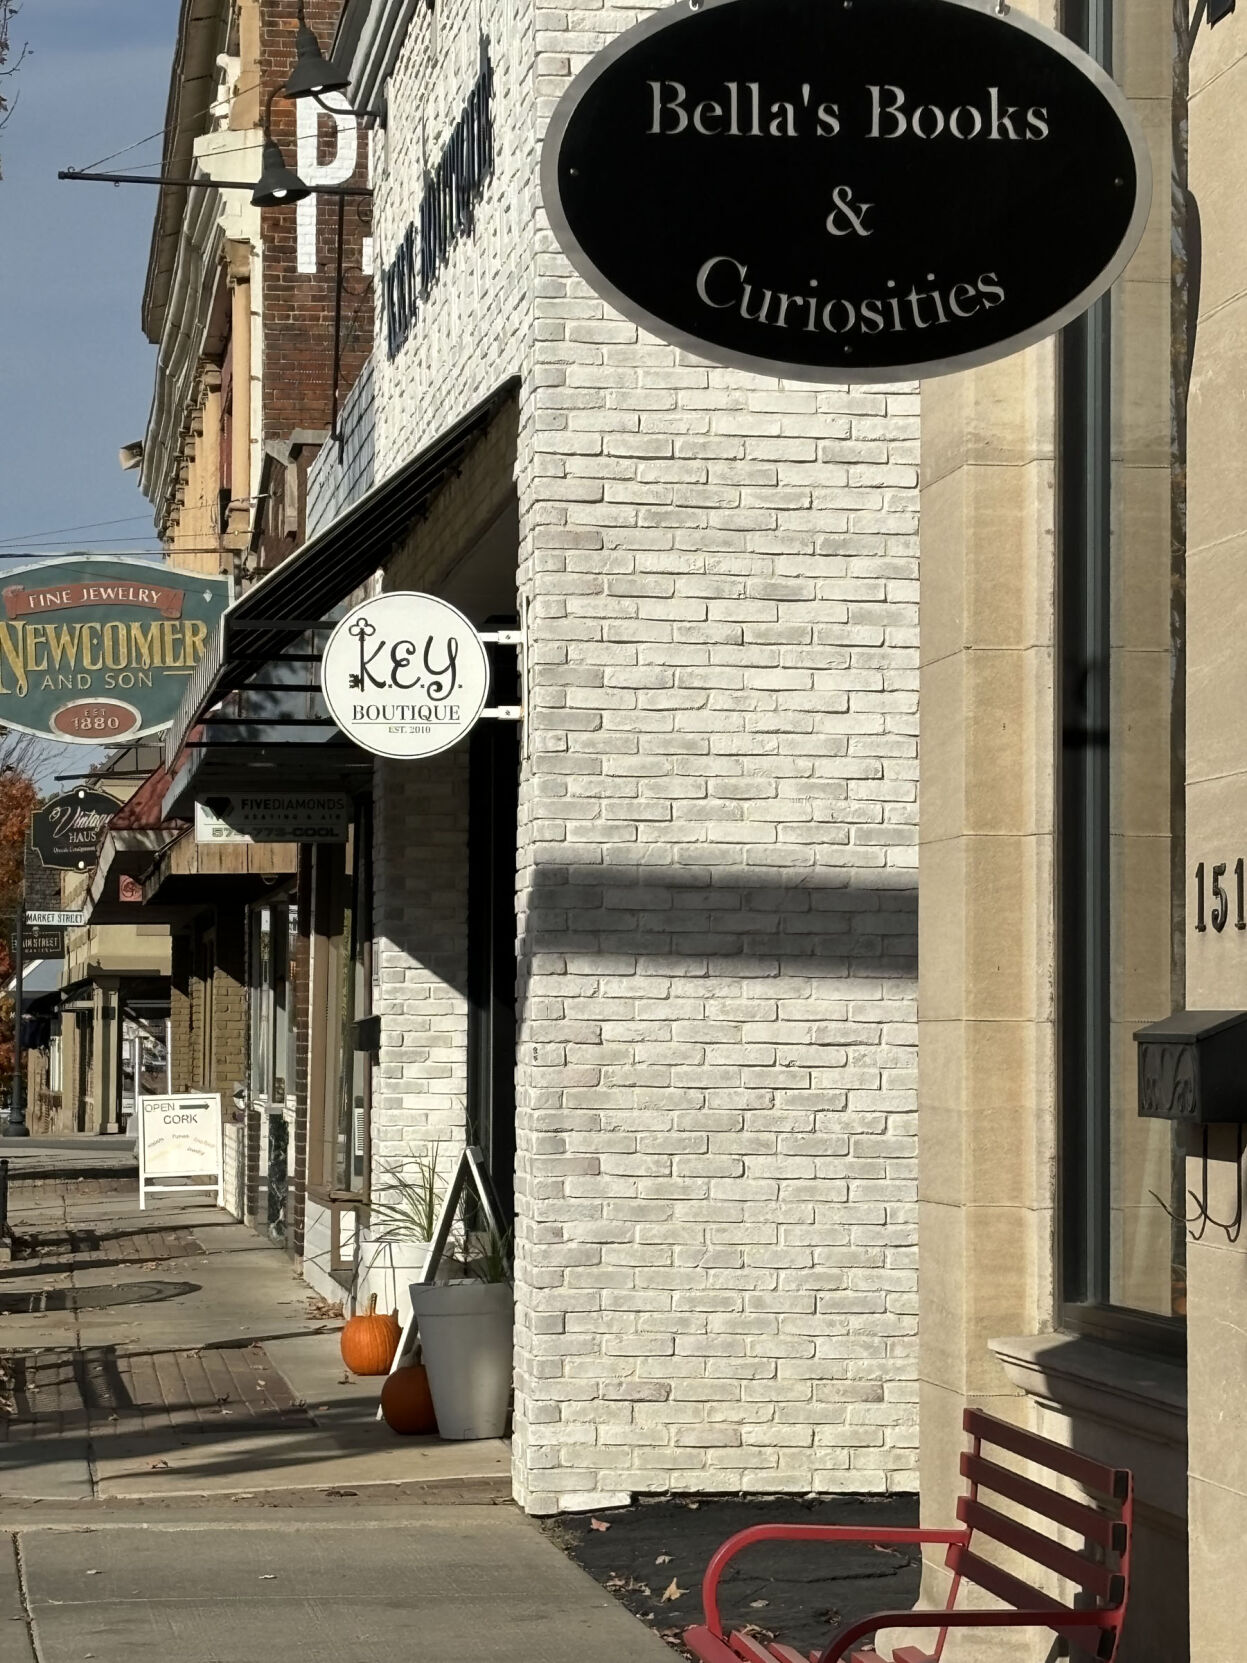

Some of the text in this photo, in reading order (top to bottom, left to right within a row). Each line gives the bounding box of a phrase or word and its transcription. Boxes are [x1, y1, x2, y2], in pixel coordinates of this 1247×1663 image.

[646, 80, 1050, 141] Bella's Books
[296, 90, 373, 275] P
[826, 185, 874, 236] &
[696, 255, 1005, 335] Curiosities
[29, 587, 162, 608] FINE JEWELRY
[0, 620, 208, 697] NEWCOMER
[41, 671, 153, 690] AND SON
[84, 708, 106, 717] EST
[352, 704, 460, 722] BOUTIQUE
[71, 716, 120, 730] 1880
[388, 726, 431, 734] EST. 2010
[69, 831, 97, 843] HAUS
[26, 913, 83, 924] MARKET STREET
[144, 1102, 175, 1113] OPEN
[163, 1113, 198, 1125] CORK
